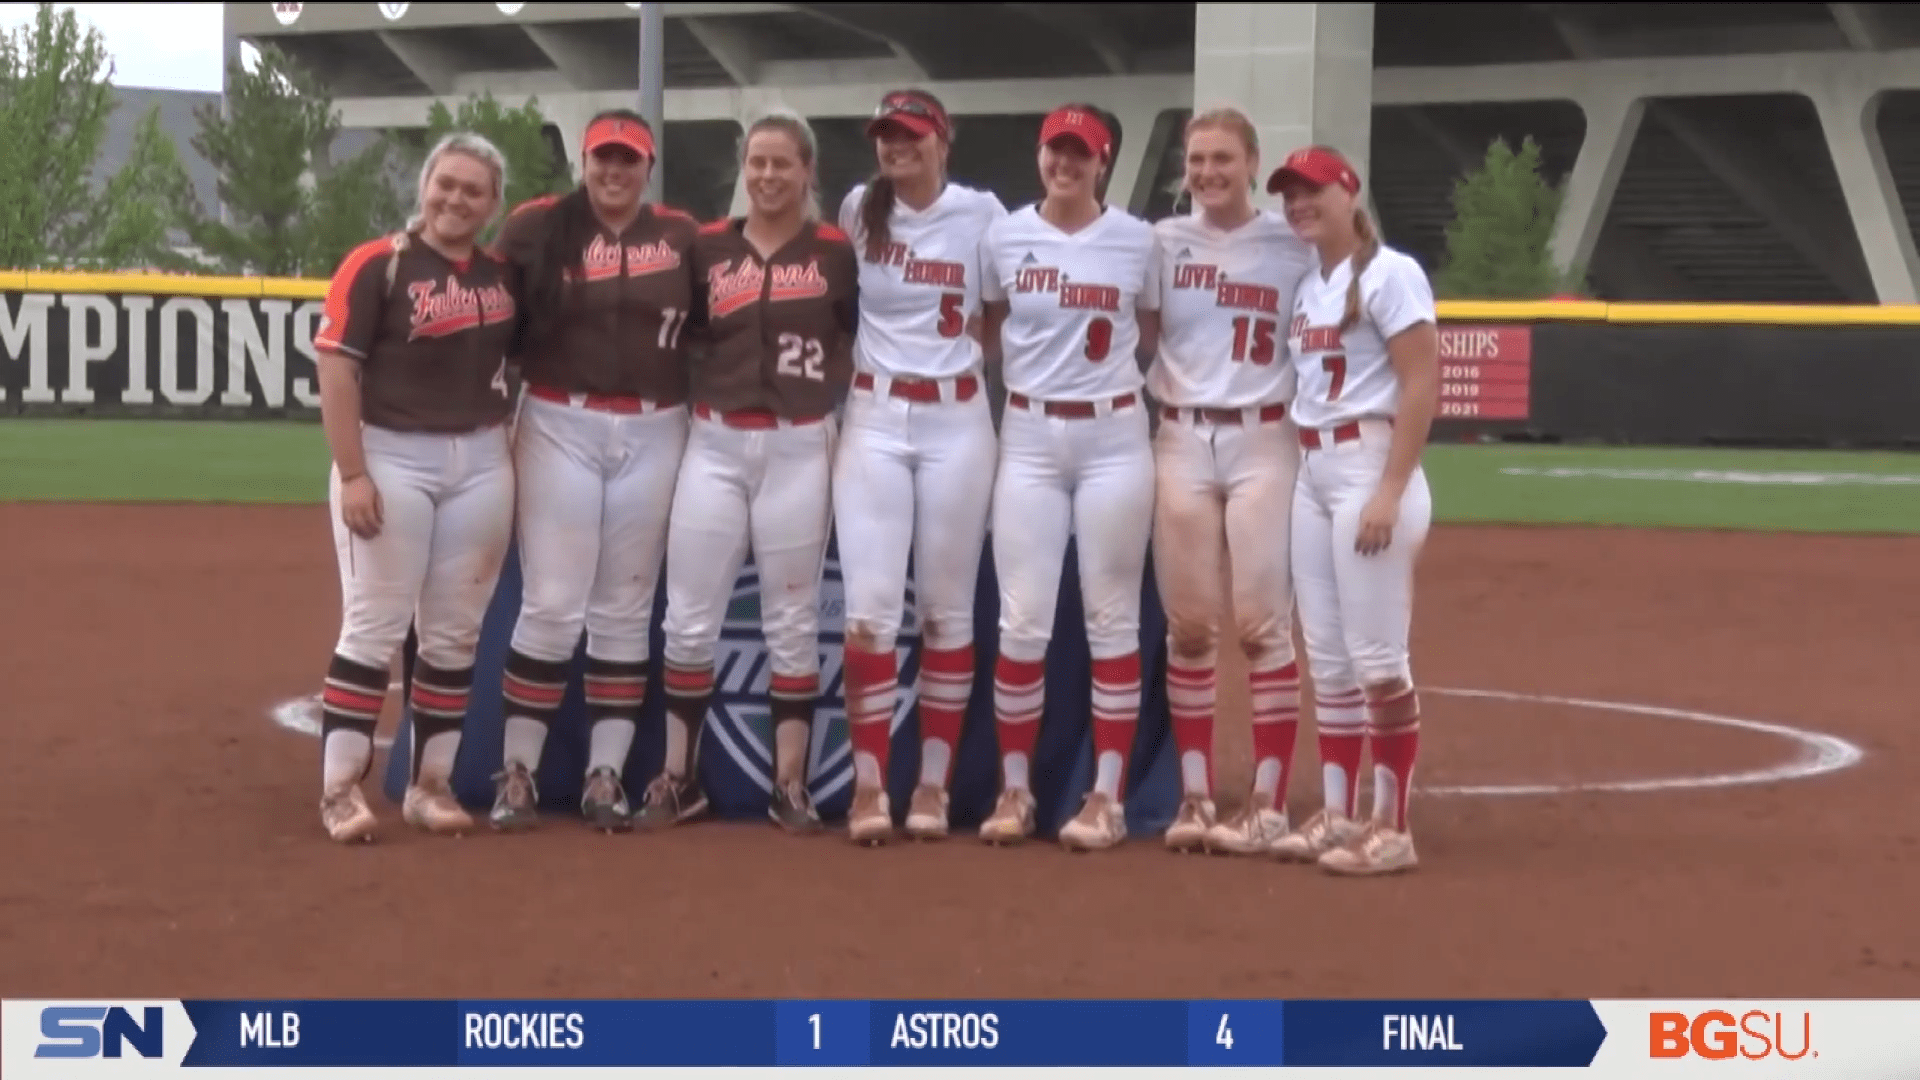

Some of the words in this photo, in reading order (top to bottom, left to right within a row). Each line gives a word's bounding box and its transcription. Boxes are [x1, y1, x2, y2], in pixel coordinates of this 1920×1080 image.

[1015, 267, 1059, 294] LOVE
[1173, 264, 1217, 289] LOVE
[937, 293, 964, 339] 5
[777, 332, 825, 382] 22
[1084, 317, 1113, 364] 9
[1231, 317, 1276, 366] 15
[1437, 329, 1499, 359] SHIPS
[491, 355, 508, 399] 4
[1322, 355, 1347, 402] 7
